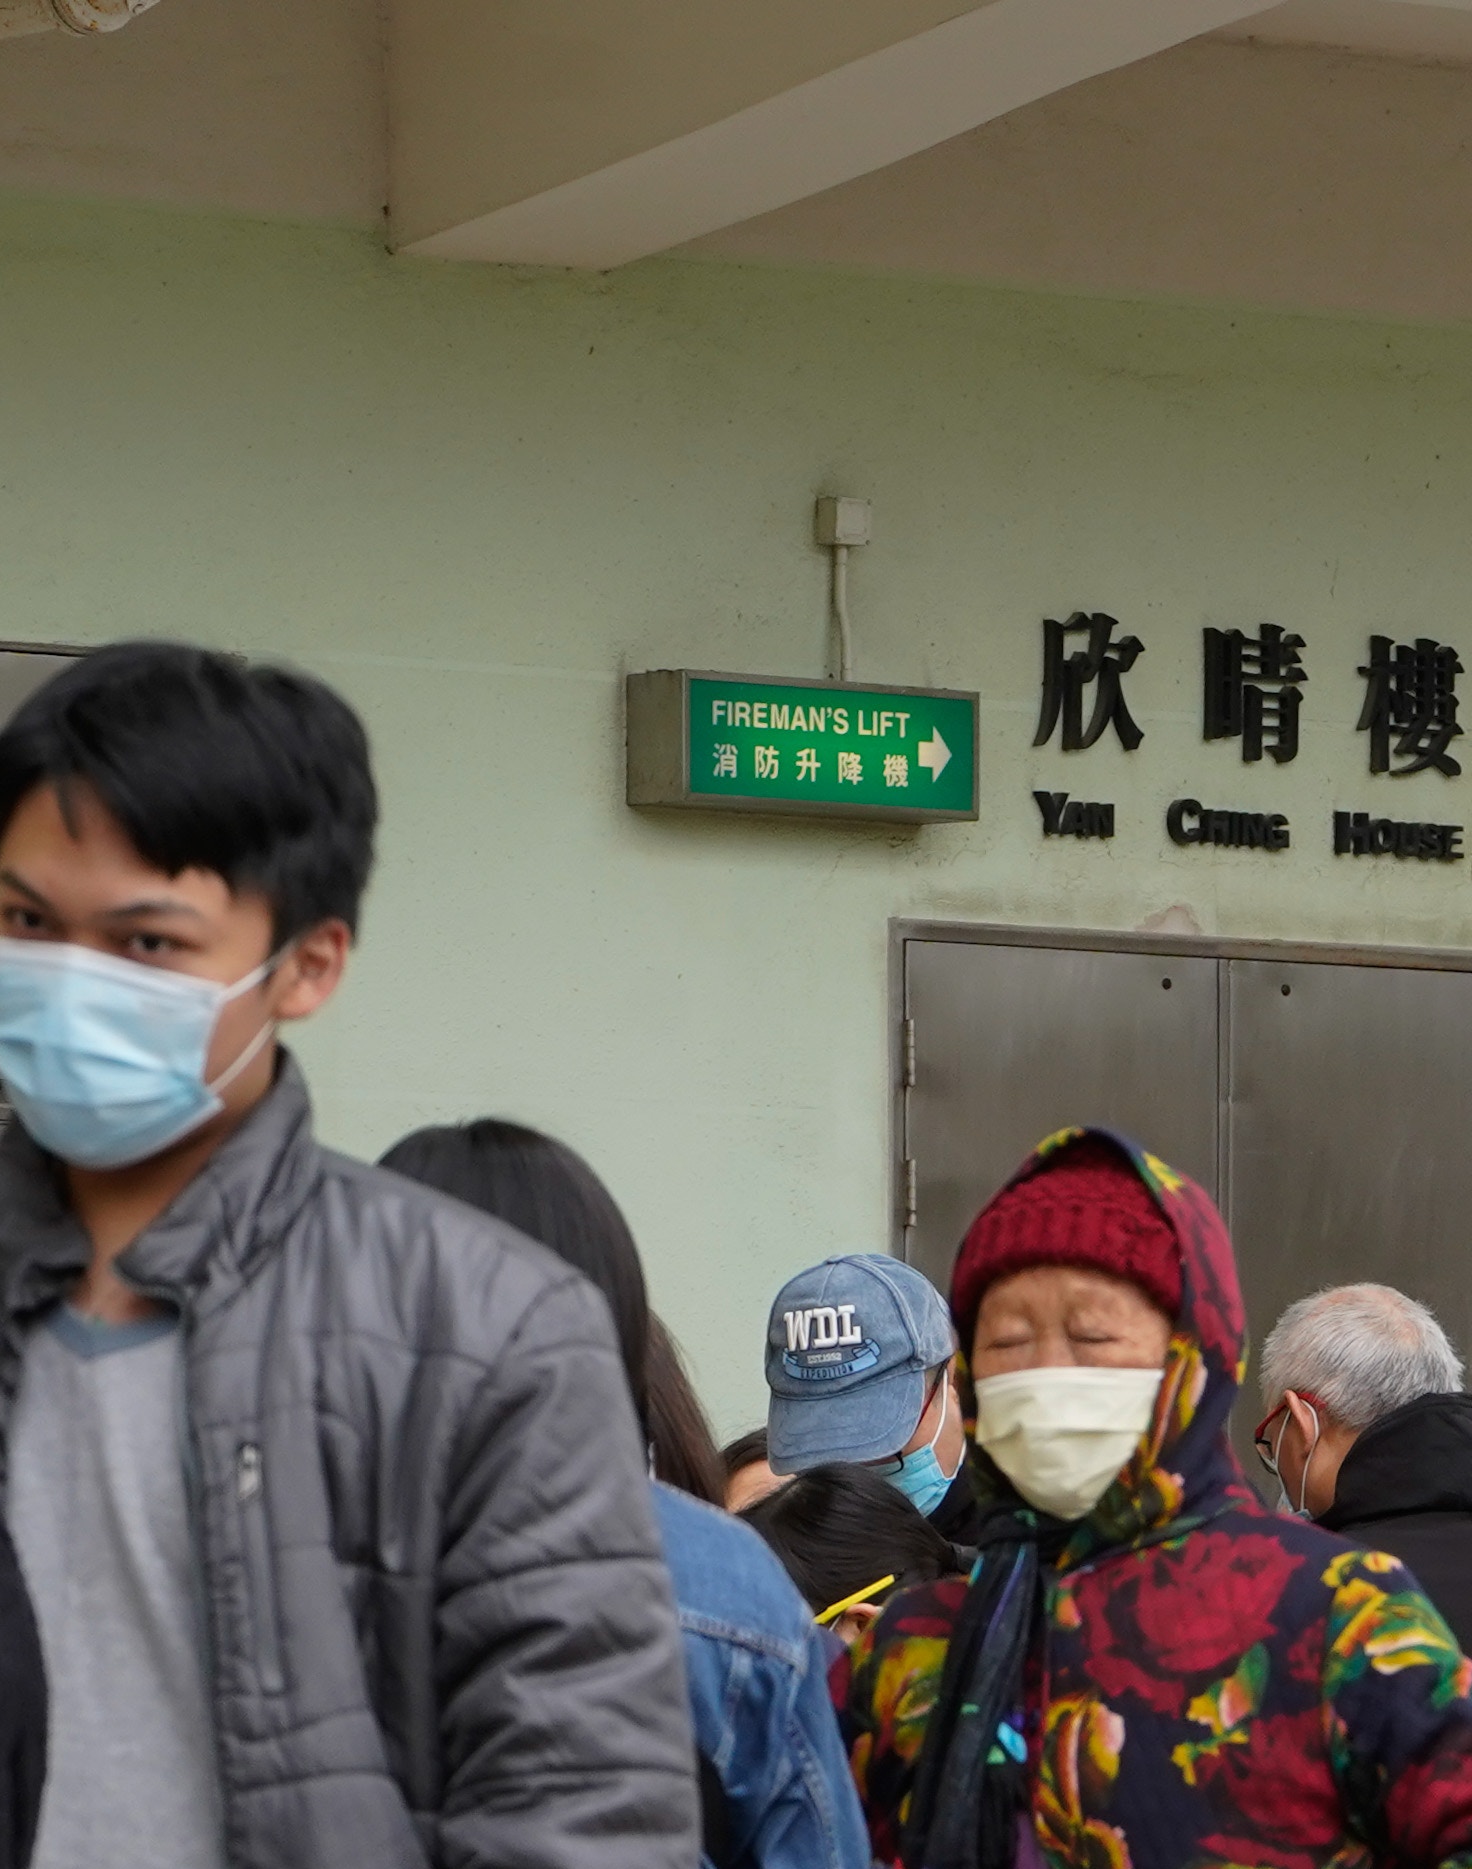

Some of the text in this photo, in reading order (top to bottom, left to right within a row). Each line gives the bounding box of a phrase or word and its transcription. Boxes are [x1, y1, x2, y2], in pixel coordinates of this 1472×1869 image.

[1032, 611, 1465, 777] 欣晴樓
[712, 699, 910, 738] FIREMAN'S LIFT
[712, 743, 909, 787] 消防升降機
[783, 1304, 862, 1352] WDL
[800, 1363, 854, 1379] EXPEDITION
